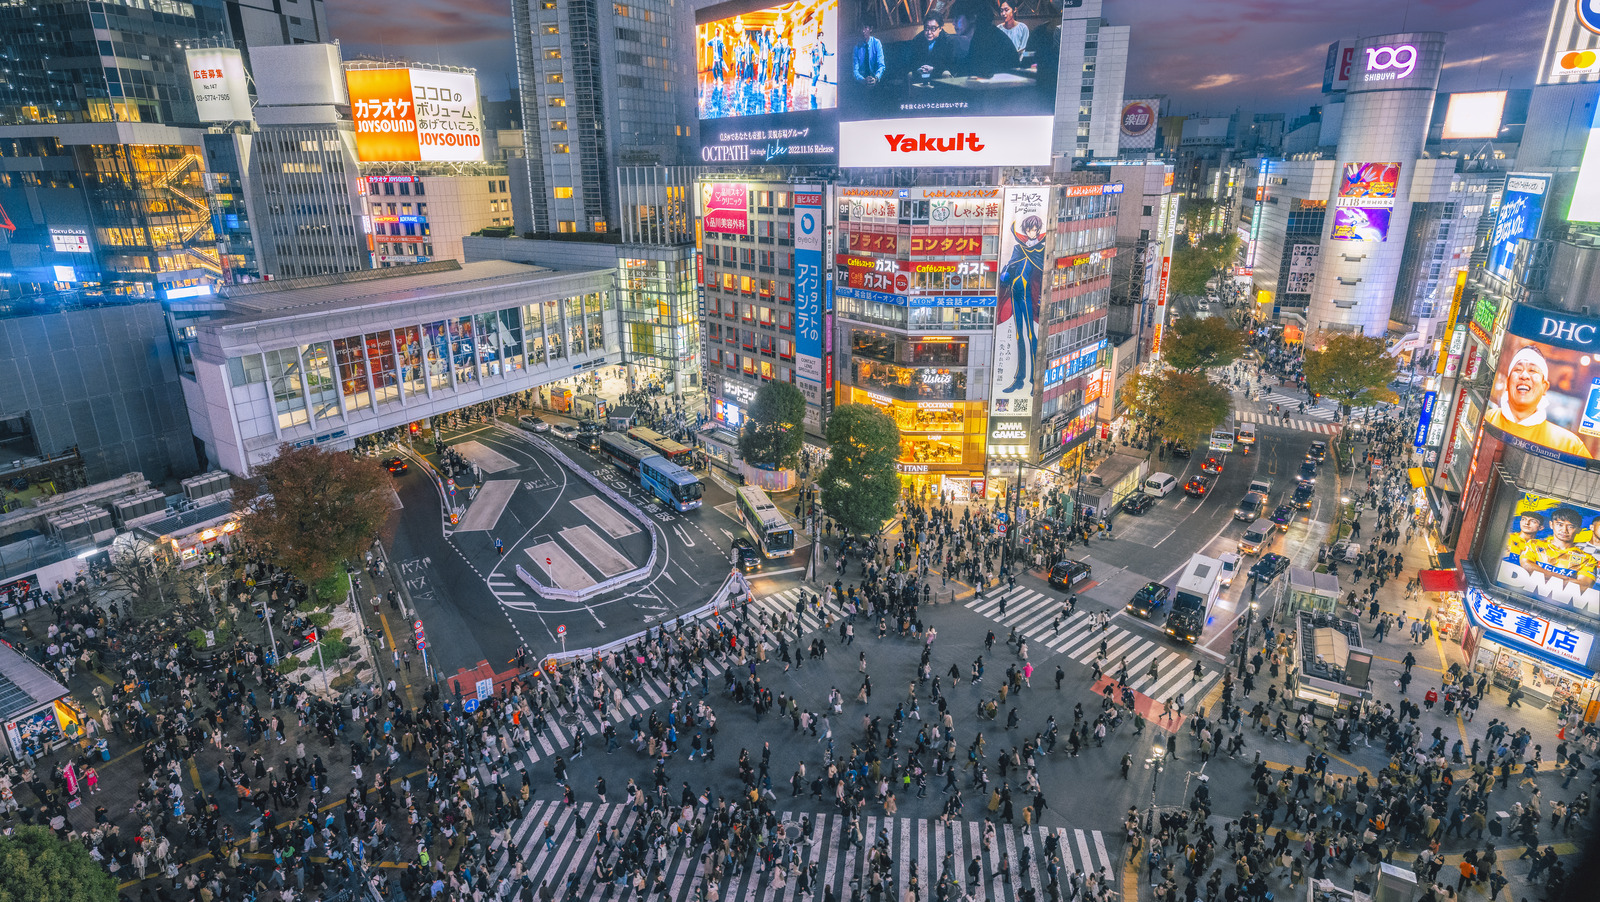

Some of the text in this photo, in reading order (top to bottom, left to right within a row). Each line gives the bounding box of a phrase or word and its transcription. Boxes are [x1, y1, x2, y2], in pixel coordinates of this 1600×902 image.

[1366, 45, 1417, 79] 109
[193, 69, 223, 79] 広告募集
[1364, 72, 1396, 82] SHIBUYA
[414, 85, 462, 102] ココロの
[354, 98, 411, 118] カラオケ
[416, 102, 477, 119] ボリューム、
[358, 119, 415, 133] JOYSOUND
[419, 119, 479, 131] あげていこう。
[1124, 113, 1150, 126] 楽園
[420, 132, 480, 147] JOYSOUND
[884, 133, 985, 152] Yakult
[702, 145, 749, 161] OCTPATH
[788, 146, 813, 154] 2022.11.16
[814, 144, 835, 153] Release
[923, 189, 999, 198] しゃぶしゃぶバイキング
[839, 204, 849, 213] 9F
[1338, 198, 1360, 206] 11.18
[865, 203, 896, 217] しゃぶ葉
[954, 203, 999, 218] しゃぶ葉
[710, 217, 746, 230] 品川美容外科
[1167, 209, 1177, 238] CAMERA
[797, 236, 819, 246] eyecity
[850, 234, 896, 249] プライス
[911, 237, 980, 251] コンタクト
[876, 260, 899, 273] ガスト
[957, 262, 990, 275] ガスト
[838, 271, 849, 281] 7F
[863, 272, 892, 290] ガスト
[1159, 276, 1168, 302] TaxFree
[798, 263, 809, 339] アイシティ
[810, 265, 819, 341] コンタクトの
[854, 290, 894, 303] 英会話イーオン
[936, 298, 996, 306] 英会話イーオン
[1540, 317, 1597, 344] DHC
[378, 338, 403, 348] nothng
[1044, 366, 1064, 382] AGA
[724, 381, 758, 401] サンドラッ
[1079, 401, 1097, 419] LUSH
[1425, 394, 1434, 413] MIZUNO
[997, 422, 1023, 431] DMM
[992, 430, 1027, 439] GAMES
[1513, 436, 1561, 460] DHC Channel
[1544, 564, 1574, 578] にしたん
[1496, 559, 1600, 615] DMM
